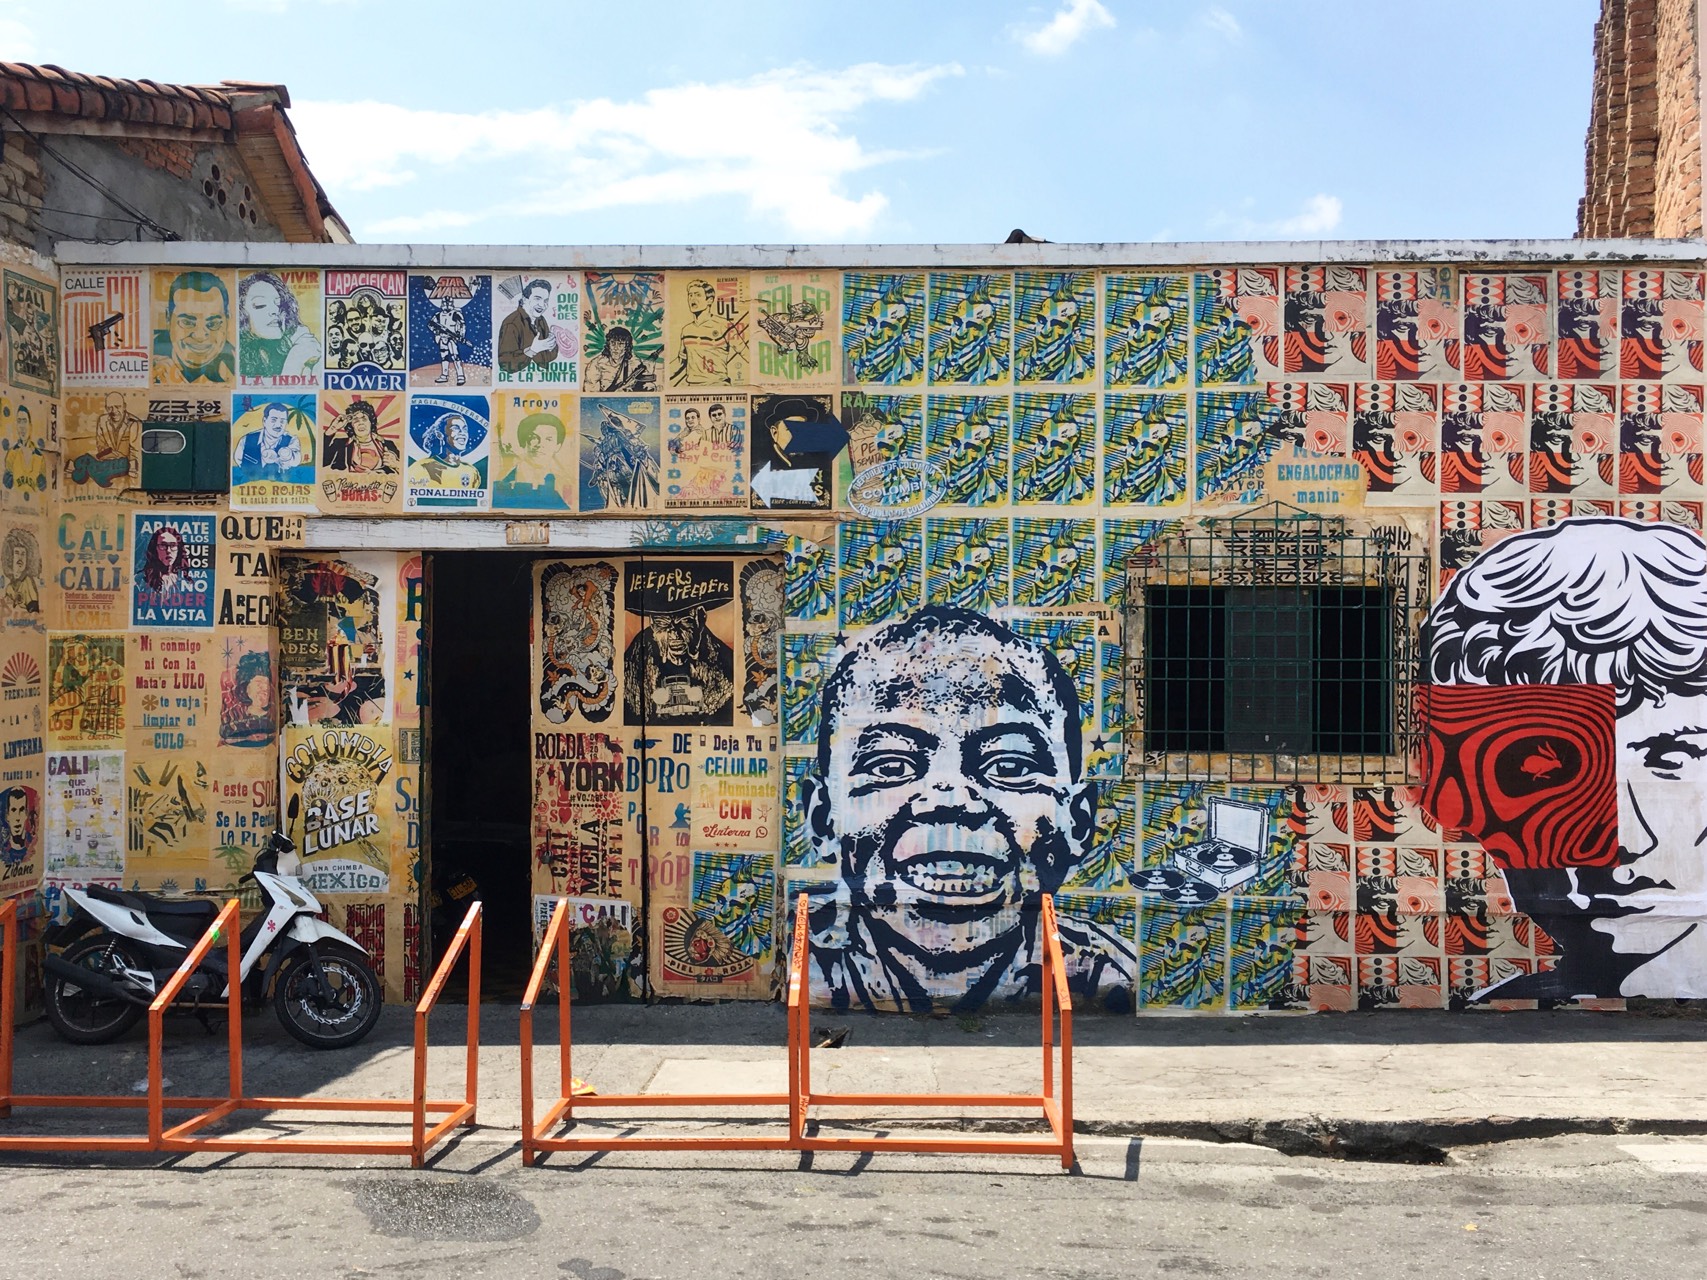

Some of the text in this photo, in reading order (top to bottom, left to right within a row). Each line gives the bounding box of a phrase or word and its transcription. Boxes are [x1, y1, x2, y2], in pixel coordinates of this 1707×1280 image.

[65, 277, 105, 290] CALLE
[281, 272, 320, 284] VIVIR
[438, 276, 464, 287] STAR
[430, 286, 473, 299] WARS
[557, 293, 579, 304] DIO
[758, 284, 831, 316] SALSA
[557, 304, 578, 312] ME
[557, 313, 578, 321] DES
[109, 360, 149, 373] CALLE
[500, 362, 577, 372] EL CACIQUE
[241, 375, 320, 387] LA INDIA
[328, 374, 403, 391] POWER
[499, 372, 577, 383] DE LA JUNTA
[411, 398, 439, 406] MAGIA
[513, 397, 559, 410] Arroyo
[1277, 464, 1360, 481] ENGALOCHAO
[239, 485, 311, 496] TITO ROJAS
[410, 488, 485, 498] RONALDINHO
[862, 481, 933, 499] COLOMBIA
[140, 521, 209, 534] ARMATE
[221, 515, 284, 541] QUE
[190, 534, 209, 543] LOS
[184, 544, 209, 557] SUE
[230, 552, 279, 579] TAN
[60, 566, 122, 592] CALI
[181, 579, 208, 593] NO
[138, 594, 206, 607] PERDER
[137, 608, 207, 621] LA VISTA
[140, 635, 201, 654] Ni conmigo
[144, 658, 196, 670] ni Con la
[173, 673, 205, 689] LULO
[160, 696, 169, 707] te
[143, 714, 196, 729] limpiar el
[3, 736, 43, 760] LINTERNA
[154, 732, 184, 749] CULO
[673, 732, 692, 754] DE
[714, 735, 762, 754] Deja Tu
[48, 755, 88, 776] CALI
[285, 730, 393, 786] COLOMBIA
[705, 756, 769, 778] CELULAR
[68, 778, 86, 788] que
[560, 761, 624, 793] YORK
[212, 780, 219, 793] A
[223, 783, 248, 797] este
[306, 789, 372, 832] BASE
[719, 799, 752, 820] CON
[216, 811, 230, 828] Se
[235, 811, 247, 828] le
[303, 813, 381, 857] LUNAR
[705, 823, 751, 838] Linterna
[580, 819, 600, 895] MELA
[2, 863, 35, 881] Zidane
[301, 872, 381, 890] MEXICO
[669, 960, 752, 974] PIEL ROJA
